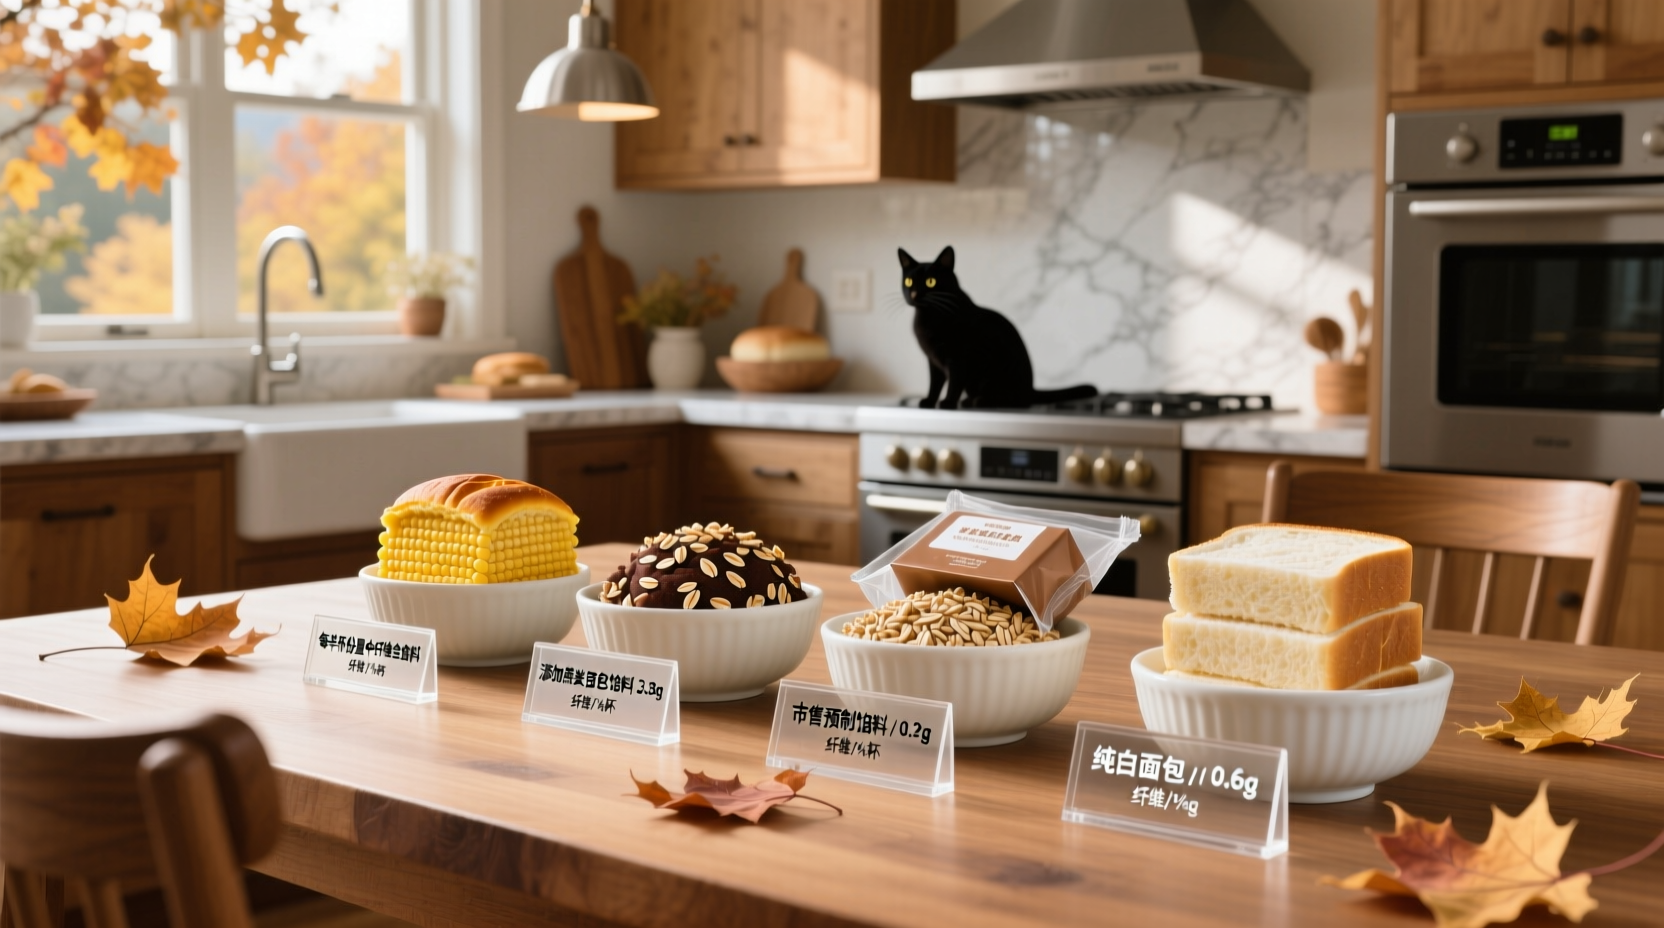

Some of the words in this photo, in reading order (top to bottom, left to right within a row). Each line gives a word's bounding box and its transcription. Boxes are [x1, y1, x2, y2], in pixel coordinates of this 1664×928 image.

[899, 720, 932, 745] 0.2g
[1090, 744, 1186, 785] 纯白面包
[1210, 765, 1259, 800] 0.6g
